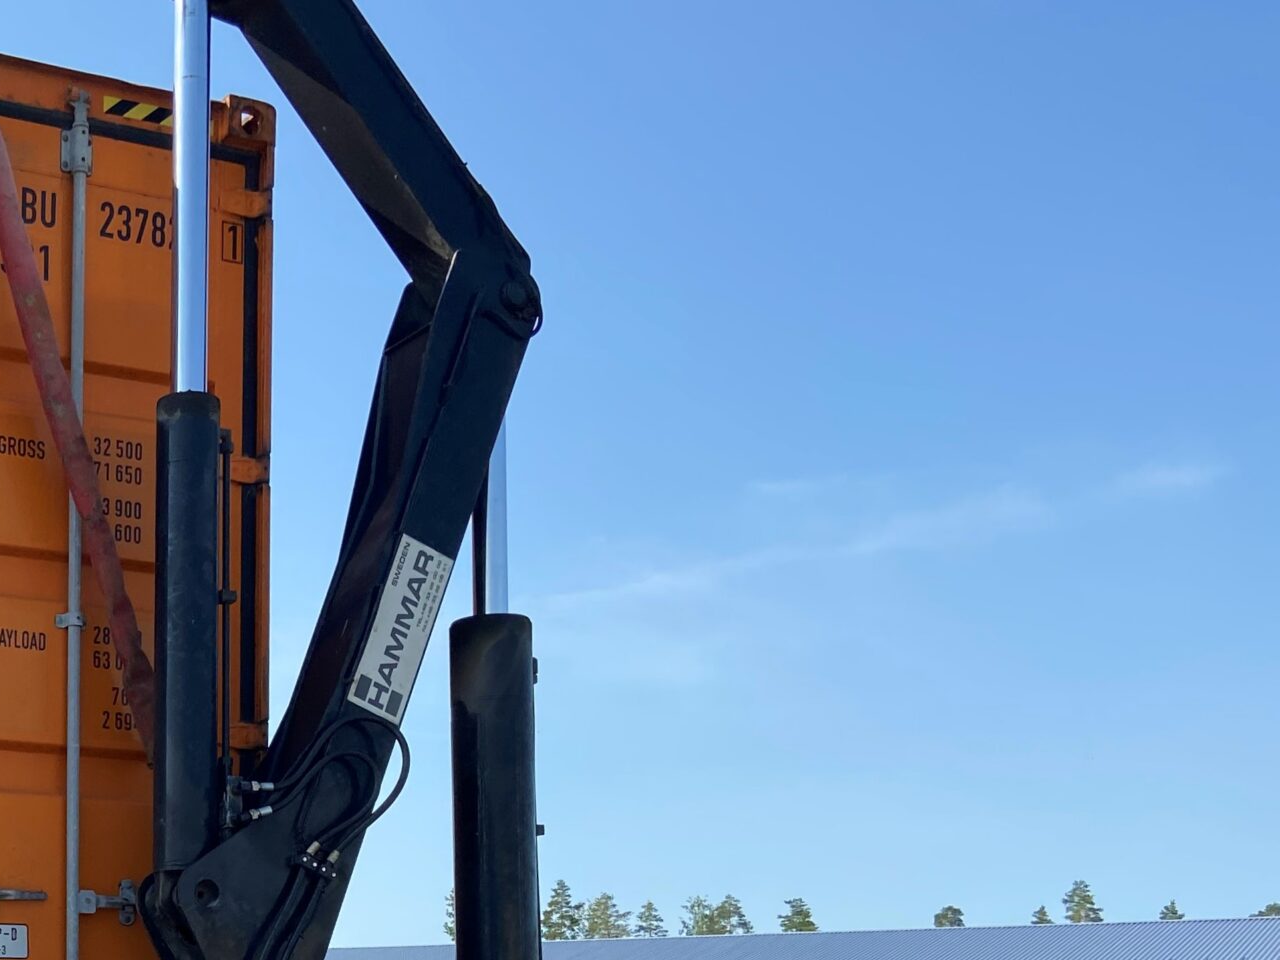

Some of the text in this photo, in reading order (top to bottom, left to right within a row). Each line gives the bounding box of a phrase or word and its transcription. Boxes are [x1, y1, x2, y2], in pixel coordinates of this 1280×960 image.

[99, 201, 173, 250] 2378
[94, 437, 111, 457] 32
[116, 440, 142, 461] 500
[116, 465, 141, 485] 650
[115, 500, 141, 519] 900
[391, 541, 411, 587] SWEDEN
[93, 626, 110, 645] 28
[367, 549, 434, 711] HAMMAR
[93, 651, 110, 669] 63
[115, 713, 136, 731] 69
